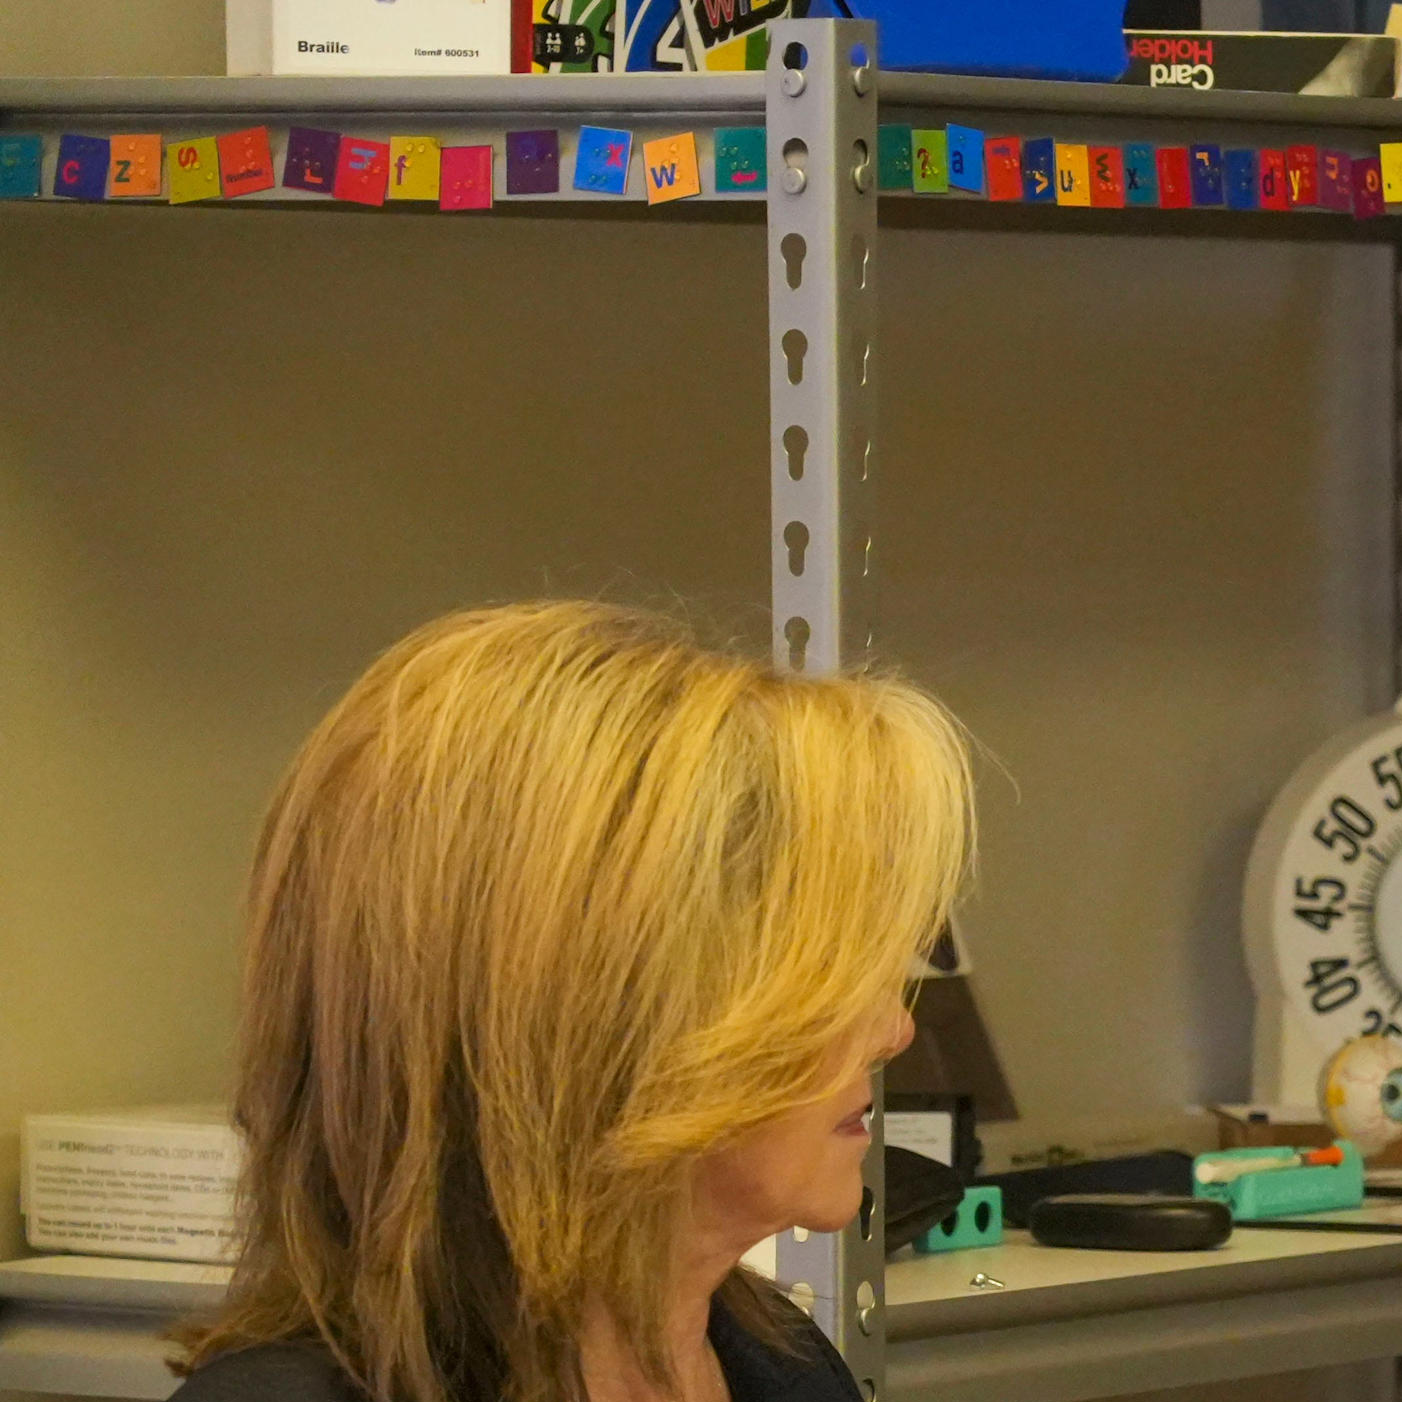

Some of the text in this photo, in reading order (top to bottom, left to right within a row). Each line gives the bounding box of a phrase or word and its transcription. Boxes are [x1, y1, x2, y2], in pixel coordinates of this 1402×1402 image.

[297, 40, 350, 55] Braille
[414, 48, 442, 58] Item#
[1129, 38, 1215, 90] Card Holder
[917, 147, 931, 179] ?
[952, 151, 965, 175] a
[1060, 170, 1074, 193] u
[1262, 167, 1275, 198] d
[1289, 169, 1301, 202] y
[1312, 795, 1378, 864] 50
[1293, 875, 1349, 933] 45
[1303, 956, 1360, 1015] 40
